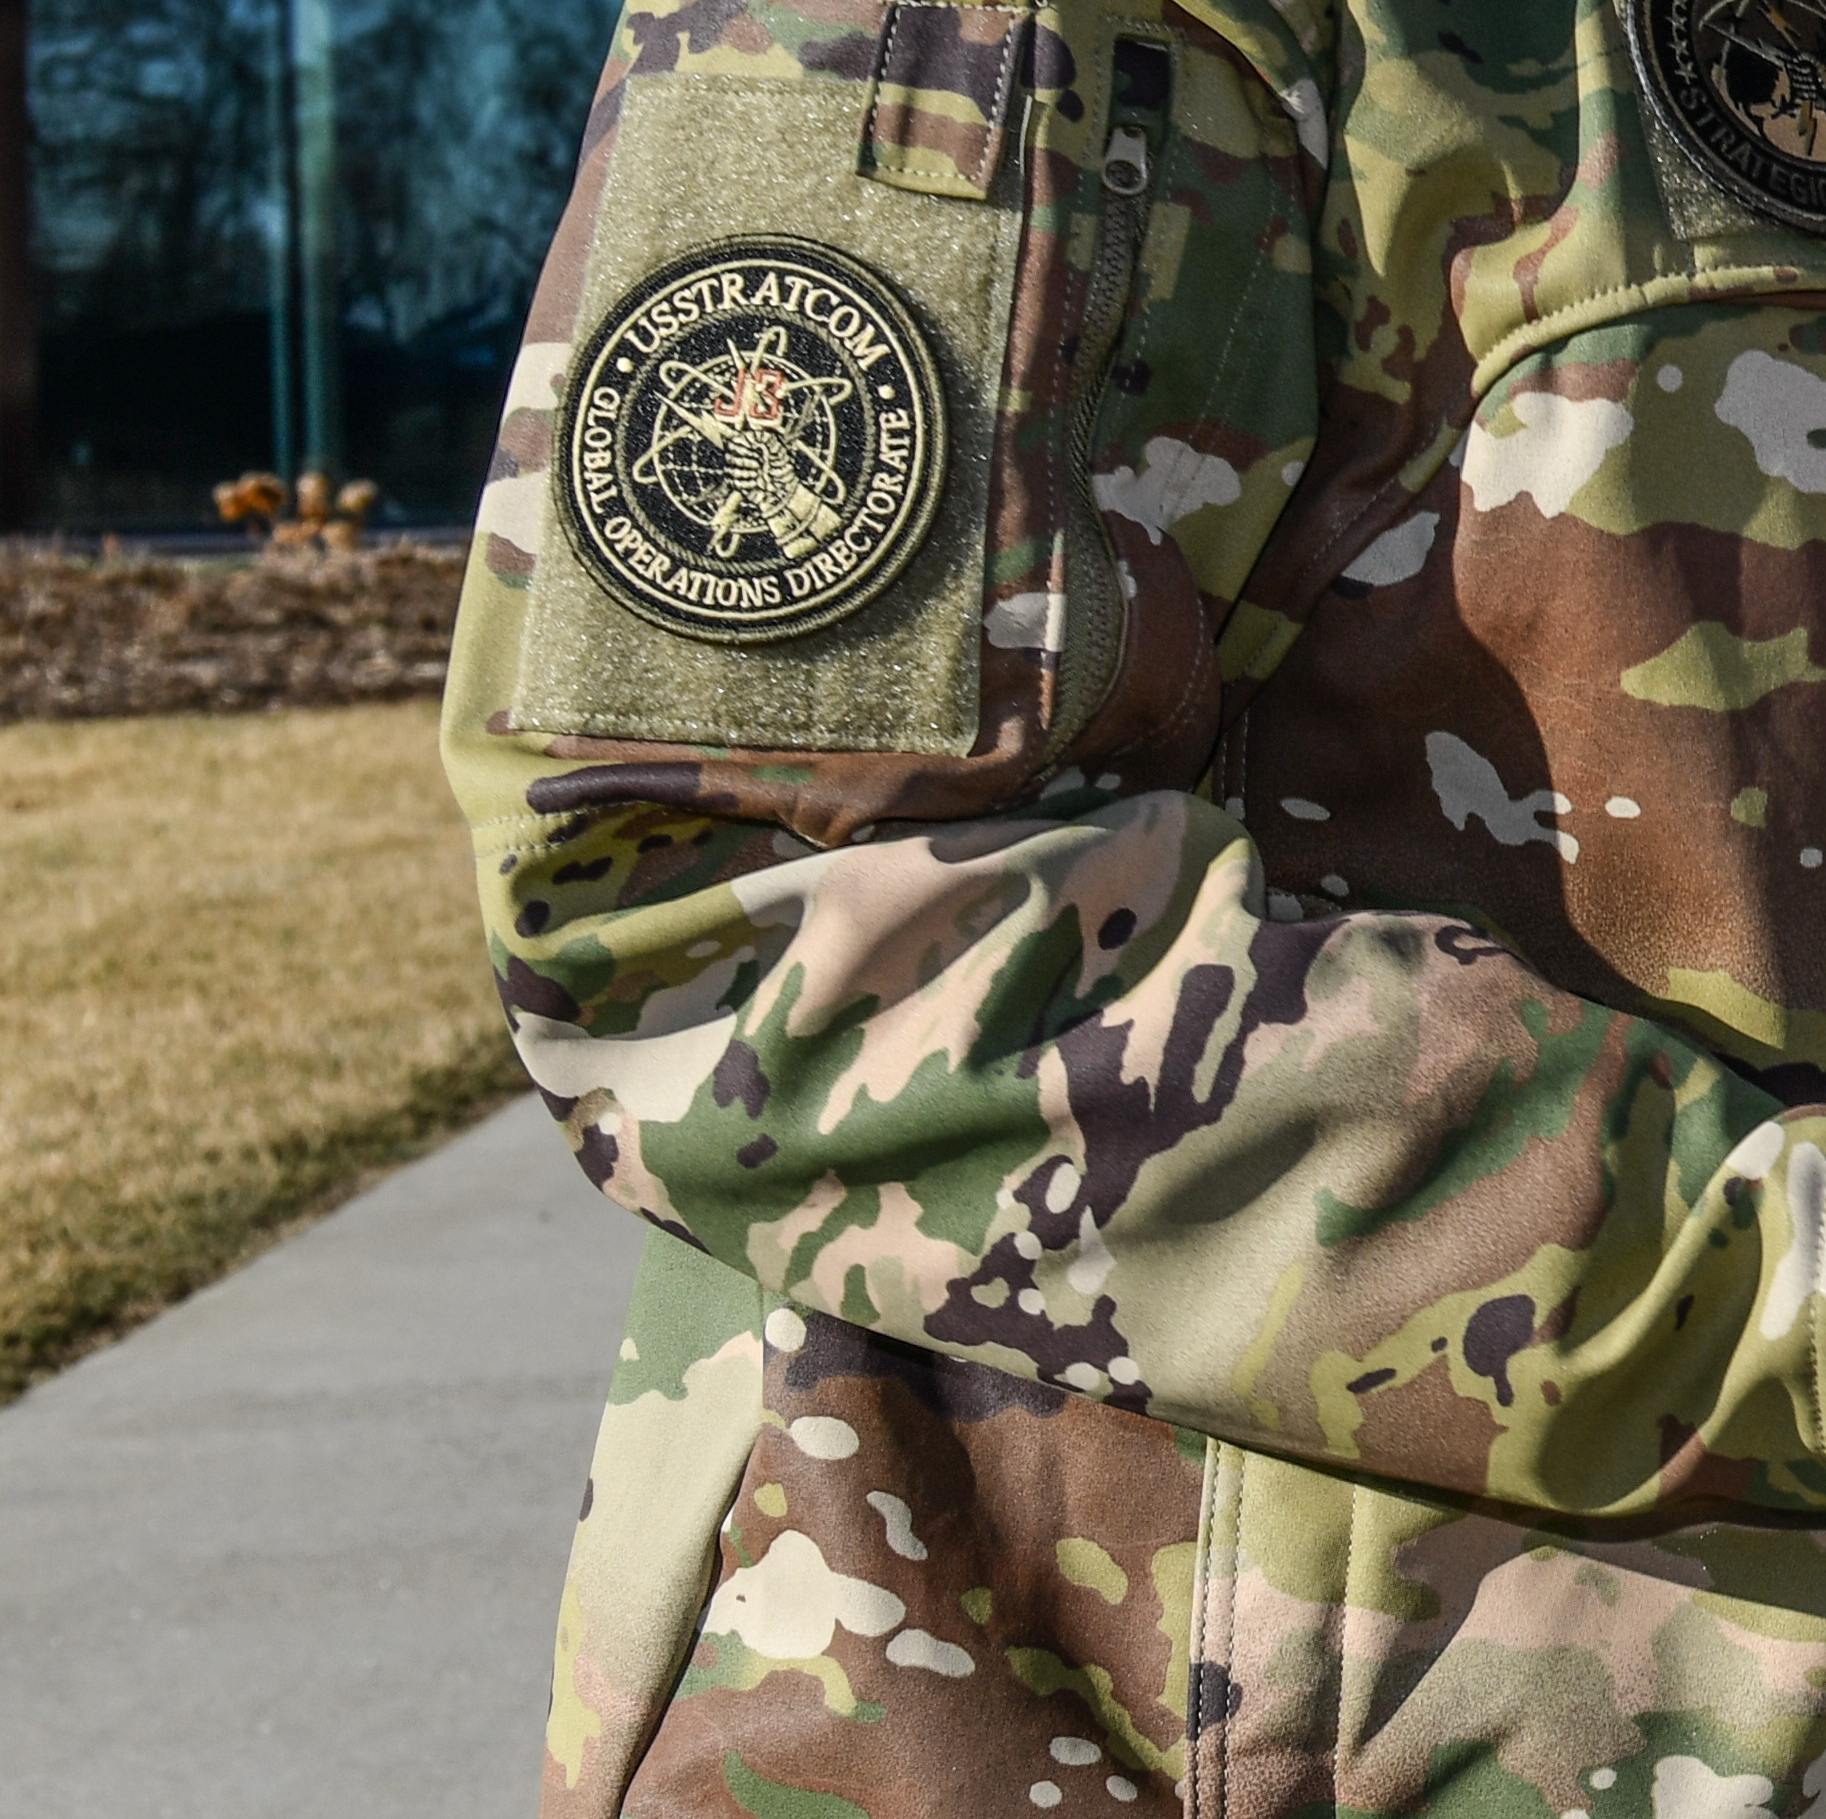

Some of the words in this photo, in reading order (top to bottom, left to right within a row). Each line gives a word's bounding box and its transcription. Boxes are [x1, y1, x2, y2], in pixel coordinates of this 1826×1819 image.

[626, 271, 892, 371] USSTRATCOM
[583, 386, 622, 515] GLOBAL
[604, 514, 781, 608] OPERATIONS
[785, 408, 907, 597] DIRECTORATE
